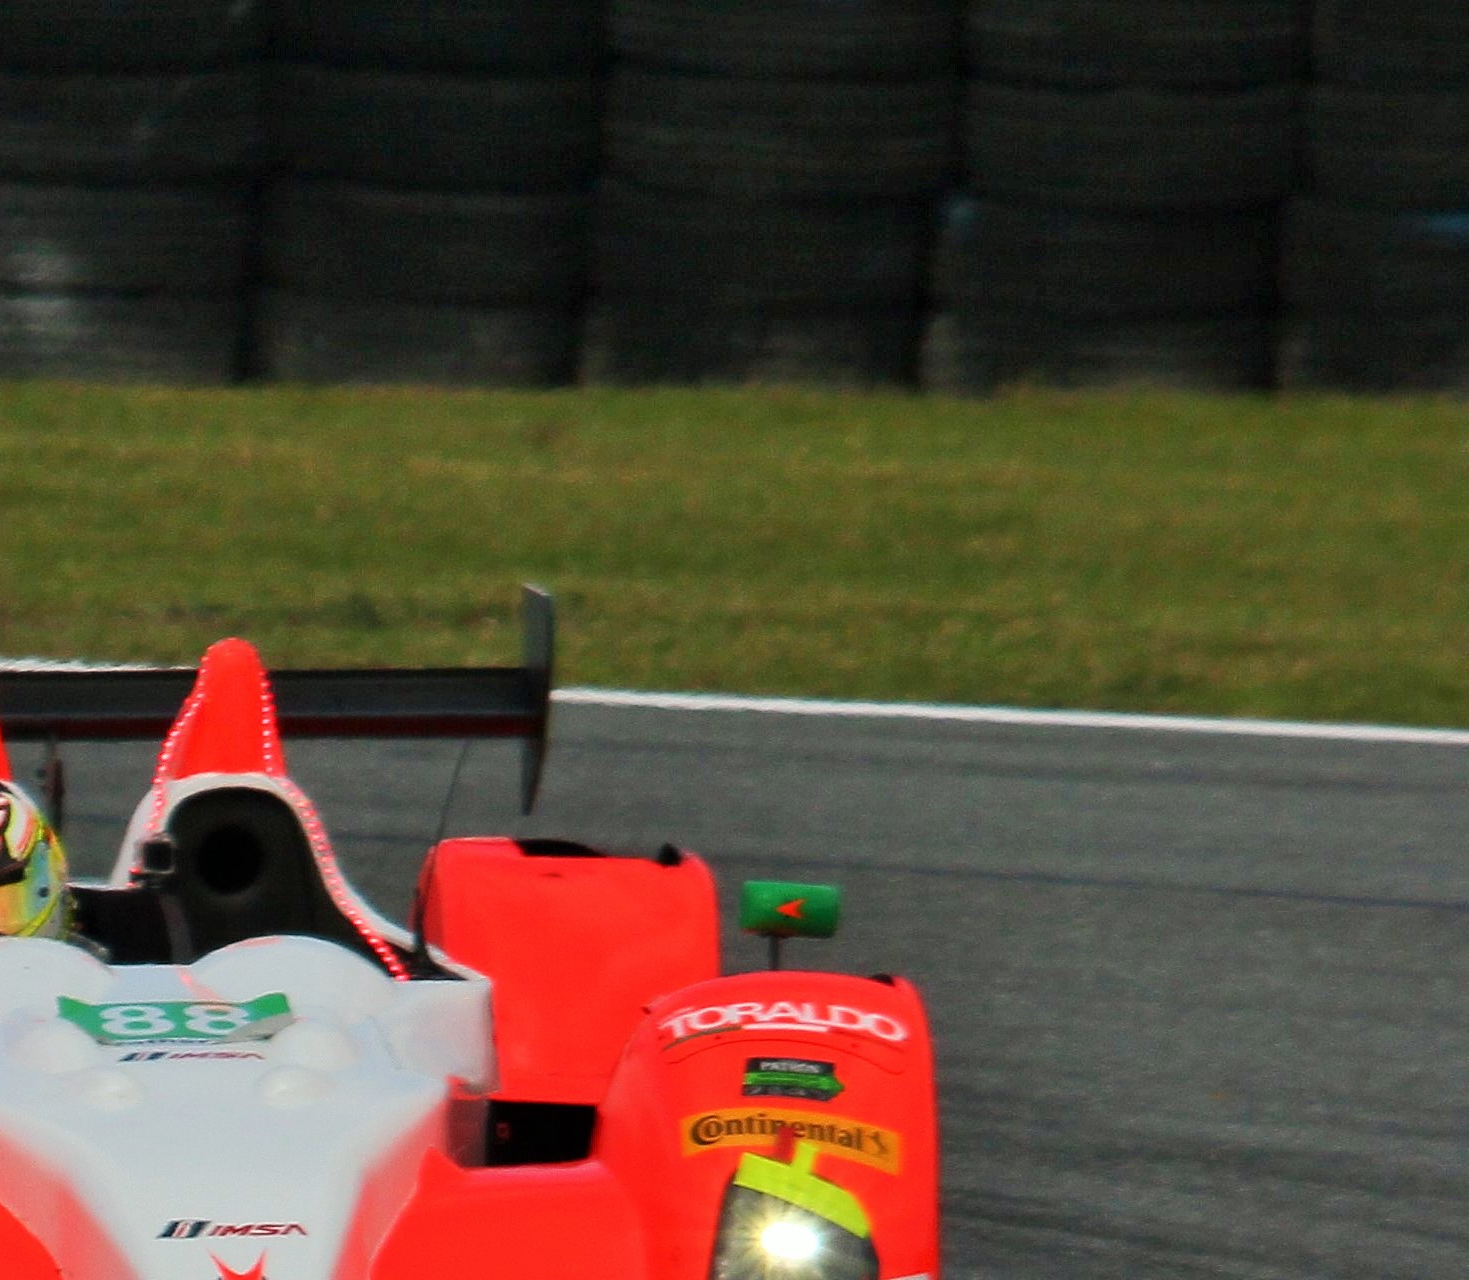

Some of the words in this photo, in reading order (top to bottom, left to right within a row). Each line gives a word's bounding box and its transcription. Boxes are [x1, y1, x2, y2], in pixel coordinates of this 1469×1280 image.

[99, 1005, 251, 1036] 88
[659, 1000, 908, 1042] TORALDO
[208, 1223, 307, 1237] IMSA
